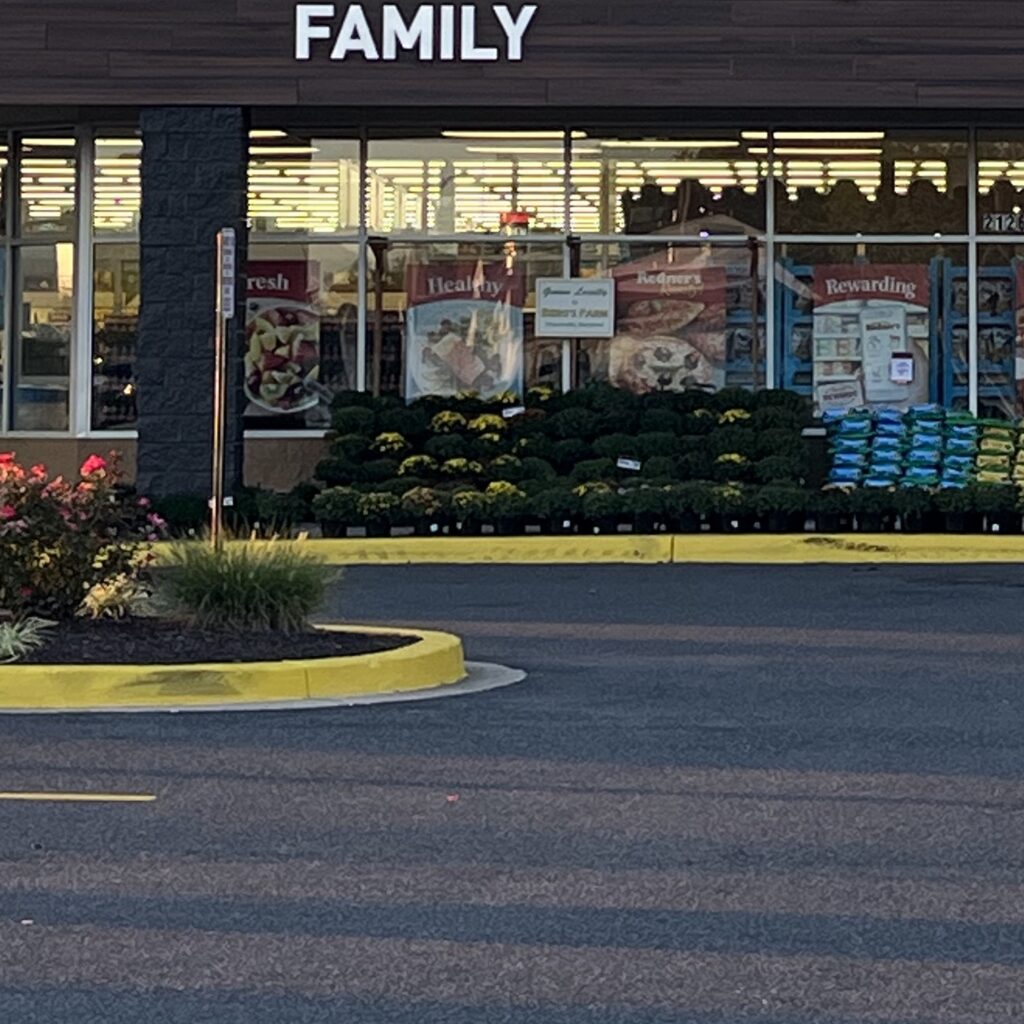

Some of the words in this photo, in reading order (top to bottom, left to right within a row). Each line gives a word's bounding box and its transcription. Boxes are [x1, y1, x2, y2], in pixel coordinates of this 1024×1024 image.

[295, 4, 537, 60] FAMILY
[246, 273, 290, 291] resh
[825, 275, 917, 299] Rewarding
